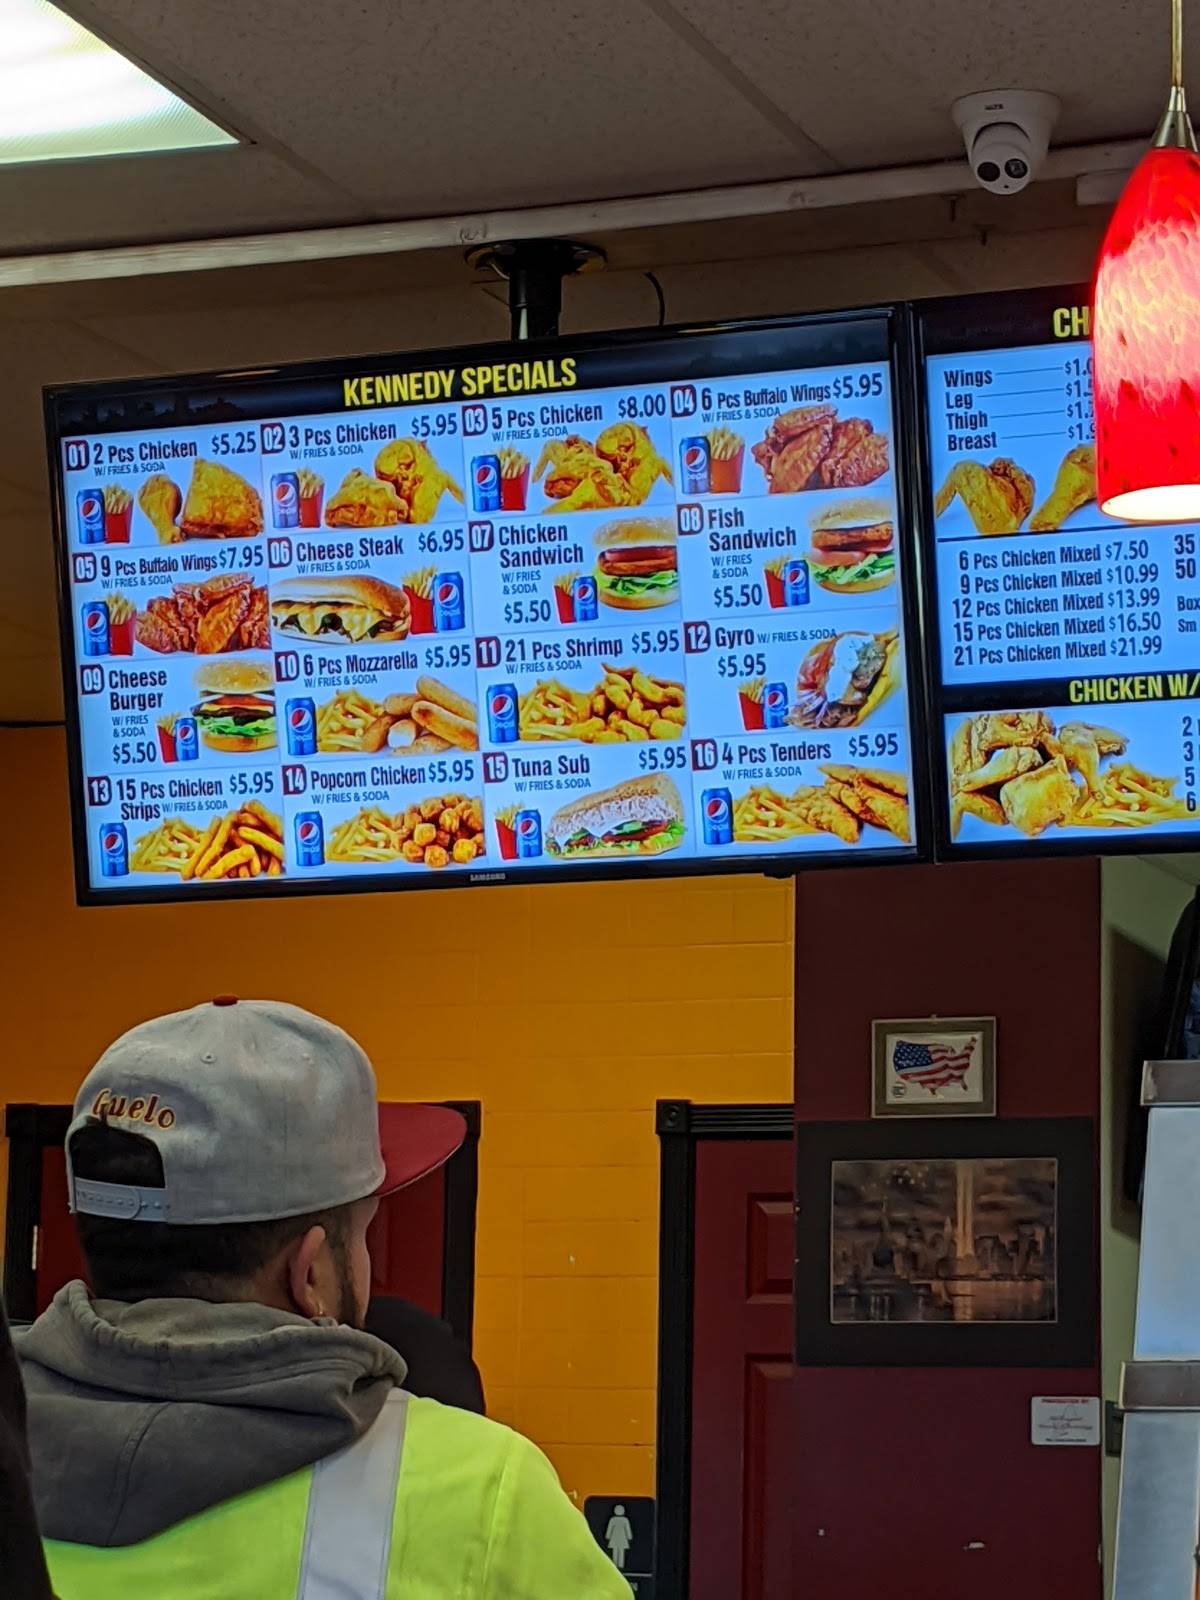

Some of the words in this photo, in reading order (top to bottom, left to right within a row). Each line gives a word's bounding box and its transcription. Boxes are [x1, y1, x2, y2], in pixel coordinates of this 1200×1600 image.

[1053, 306, 1090, 337] CH
[343, 370, 455, 406] KENNEDY
[461, 358, 577, 396] SPECIALS
[944, 370, 992, 387] Wings
[673, 390, 693, 414] 04
[702, 388, 712, 411] 6
[717, 392, 741, 409] Pcs
[744, 387, 787, 406] Buffalo
[791, 384, 831, 402] Wings
[833, 373, 883, 398] $5.95
[945, 392, 972, 409] Leg
[465, 409, 485, 432] 03
[492, 408, 502, 429] 5
[508, 410, 535, 427] Pcs
[540, 404, 602, 425] Chicken
[618, 394, 666, 418] $8.00
[946, 411, 987, 430] Thigh
[263, 427, 283, 451] 02
[289, 426, 299, 448] 3
[305, 428, 331, 446] Pcs
[336, 423, 397, 443] Chicken
[411, 413, 457, 437] $5.95
[506, 430, 531, 440] FRIES
[533, 429, 540, 438] &
[542, 427, 568, 437] SODA
[948, 432, 997, 451] Breast
[68, 444, 86, 469] 01
[94, 443, 103, 464] 2
[109, 446, 134, 463] Pcs
[139, 441, 197, 460] Chicken
[212, 432, 256, 455] $5.25
[680, 508, 701, 532] 08
[708, 507, 744, 529] Fish
[270, 542, 289, 564] 06
[296, 542, 354, 562] Cheese
[359, 536, 403, 556] Steak
[418, 529, 464, 553] $6.95
[471, 525, 491, 548] 07
[500, 524, 568, 545] Chicken
[709, 526, 797, 551] Sandwich
[1175, 534, 1195, 554] 35
[75, 556, 94, 579] 05
[102, 555, 110, 577] 9
[116, 561, 136, 575] Pcs
[140, 559, 178, 573] Buffalo
[182, 554, 217, 571] Wings
[219, 546, 263, 569] $7.95
[500, 544, 583, 568] Sandwich
[726, 554, 752, 565] FRIES
[960, 551, 968, 570] 6
[974, 553, 997, 570] Pcs
[1002, 549, 1056, 568] Chicken
[1060, 544, 1100, 563] Mixed
[1105, 540, 1148, 561] $7.50
[516, 571, 541, 581] FRIES
[712, 568, 720, 578] &
[722, 567, 748, 577] SODA
[961, 574, 970, 594] 9
[975, 577, 999, 594] Pcs
[1003, 573, 1057, 592] Chicken
[1061, 569, 1102, 587] Mixed
[1107, 563, 1159, 585] $10.99
[1176, 558, 1196, 579] 50
[502, 586, 510, 595] &
[512, 584, 537, 593] SODA
[713, 584, 762, 608] $5.50
[504, 600, 550, 624] $5.50
[953, 599, 972, 619] 12
[977, 601, 1000, 617] Pcs
[1005, 597, 1058, 615] Chicken
[1063, 592, 1103, 611] Mixed
[1108, 587, 1160, 609] $13.99
[954, 622, 973, 642] 15
[978, 625, 1001, 641] Pcs
[1006, 620, 1059, 639] Chicken
[1064, 616, 1105, 635] Mixed
[1109, 611, 1161, 633] $16.50
[1178, 619, 1197, 632] Sm
[479, 641, 498, 664] 11
[505, 639, 525, 662] 21
[533, 641, 561, 660] Pcs
[566, 637, 623, 657] Shrimp
[632, 630, 679, 654] $5.95
[688, 626, 708, 650] 12
[715, 627, 754, 650] Gyro
[772, 631, 798, 642] FRIES
[800, 631, 807, 640] &
[809, 629, 837, 639] SODA
[278, 655, 297, 678] 10
[304, 654, 312, 676] 6
[319, 657, 341, 675] Pcs
[346, 651, 418, 673] Mozzarella
[426, 645, 471, 668] $5.95
[954, 646, 973, 666] 21
[979, 648, 1003, 664] Pcs
[1007, 644, 1061, 662] Chicken
[1065, 640, 1106, 659] Mixed
[1110, 635, 1162, 657] $21.99
[718, 654, 766, 677] $5.95
[83, 669, 102, 692] 09
[109, 671, 167, 689] Cheese
[1070, 675, 1162, 703] CHICKEN
[110, 692, 163, 710] Burger
[113, 728, 120, 737] &
[121, 727, 145, 736] SODA
[126, 715, 149, 725] FRIES
[1182, 716, 1192, 736] 2
[113, 742, 156, 764] $5.50
[694, 744, 715, 768] 16
[722, 743, 732, 764] 4
[739, 745, 766, 764] Pcs
[770, 743, 831, 762] Tenders
[848, 733, 898, 757] $5.95
[1184, 741, 1193, 761] 3
[486, 757, 506, 780] 15
[512, 758, 552, 777] Tuna
[558, 754, 590, 775] Sub
[638, 747, 686, 770] $5.95
[738, 768, 763, 779] FRIES
[765, 768, 772, 777] &
[775, 766, 802, 777] SODA
[91, 780, 110, 803] 13
[117, 779, 136, 801] 15
[141, 782, 165, 799] Pcs
[169, 778, 223, 797] Chicken
[230, 772, 274, 794] $5.95
[285, 768, 304, 792] 14
[311, 770, 366, 791] Popcorn
[371, 766, 426, 786] Chicken
[428, 760, 474, 783] $5.95
[529, 781, 554, 791] FRIES
[555, 780, 562, 789] &
[565, 778, 591, 788] SODA
[1185, 767, 1194, 786] 5
[121, 802, 160, 822] Strips
[1186, 792, 1196, 812] 6
